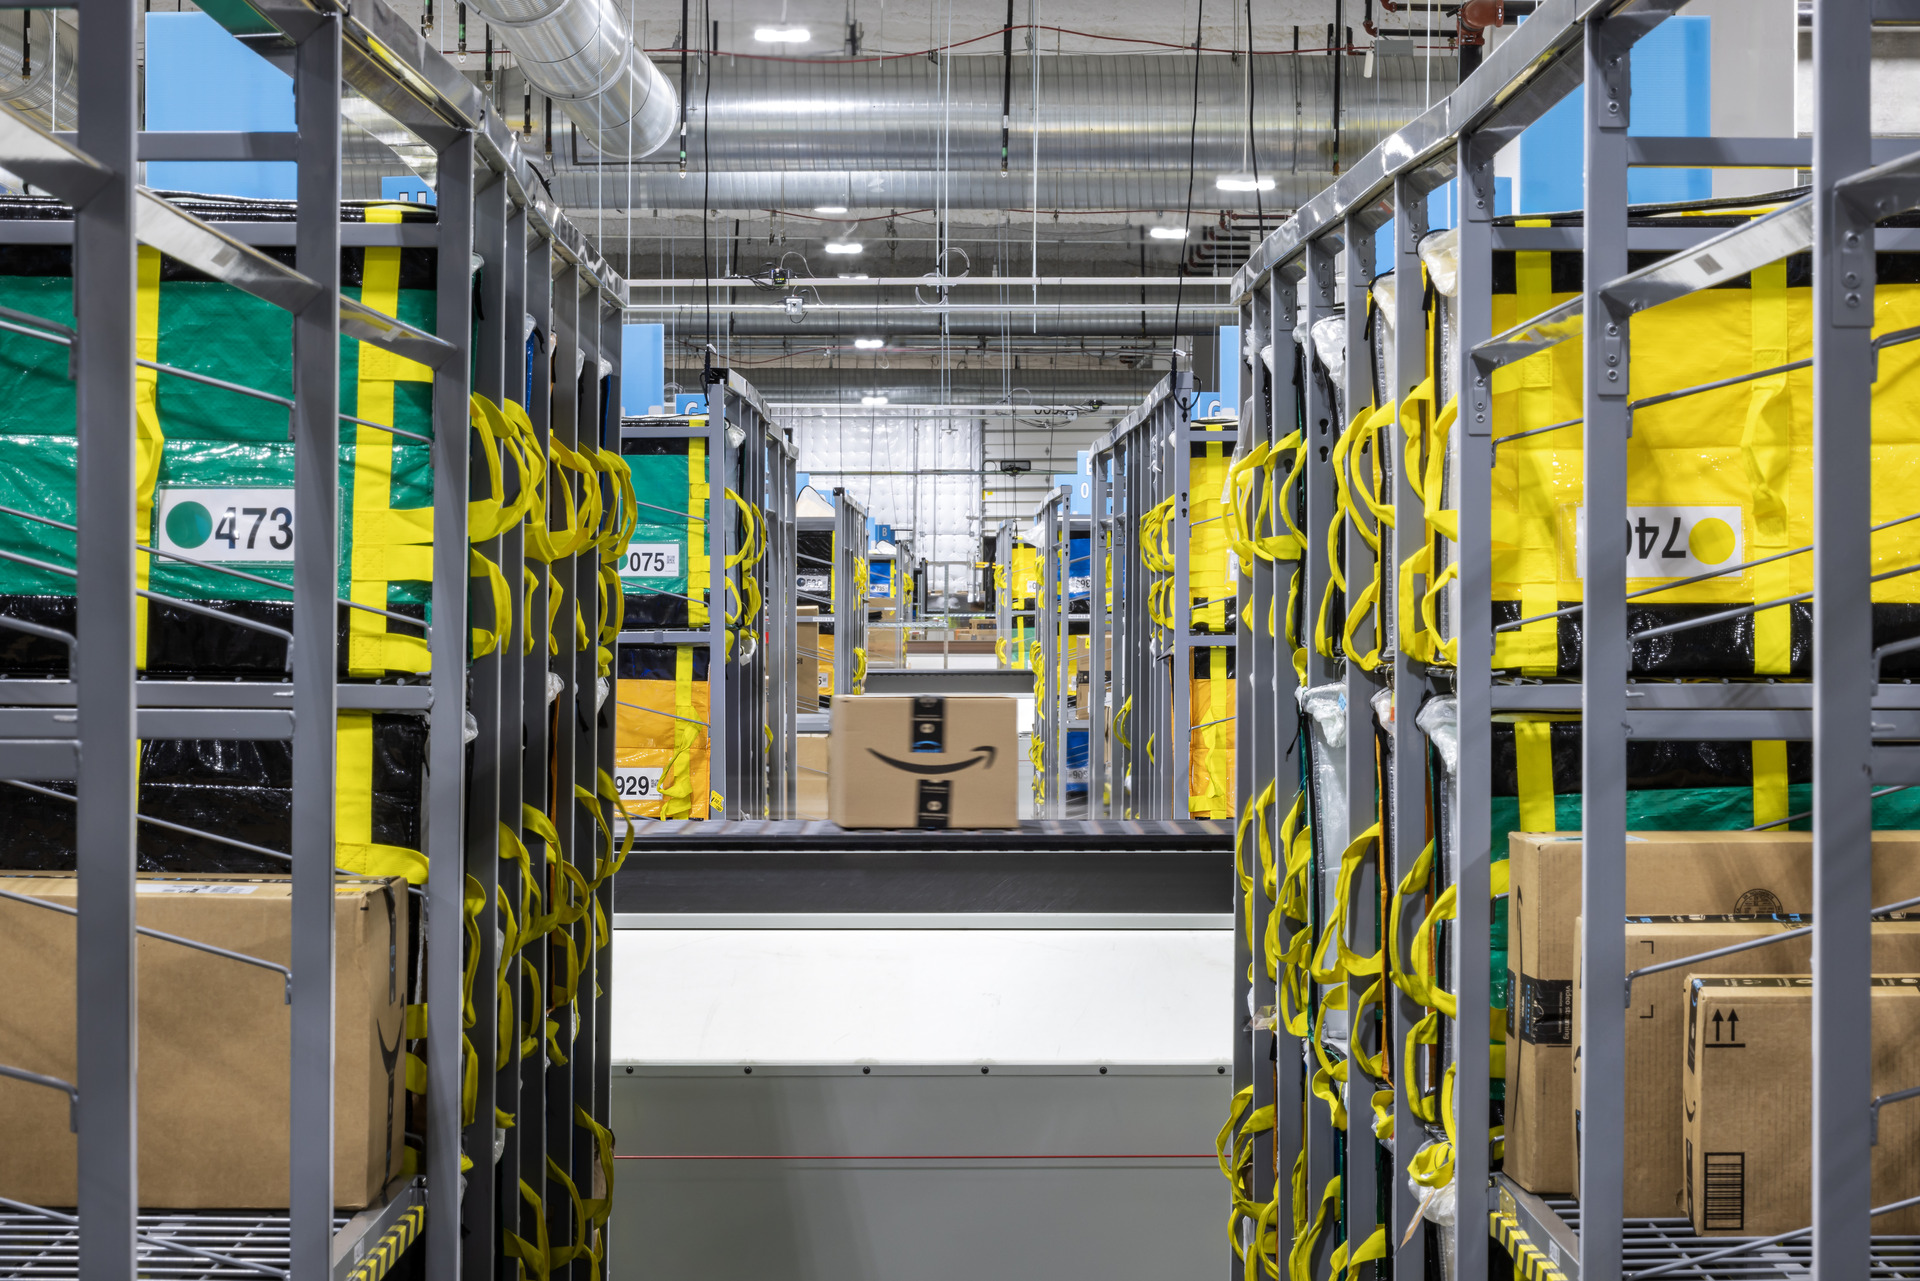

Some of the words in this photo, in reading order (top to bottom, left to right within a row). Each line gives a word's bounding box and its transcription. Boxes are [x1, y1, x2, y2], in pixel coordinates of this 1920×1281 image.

[215, 507, 293, 550] 473
[1626, 517, 1686, 559] 74
[630, 552, 665, 572] 075
[615, 776, 649, 796] 929
[1563, 1008, 1572, 1040] stming
